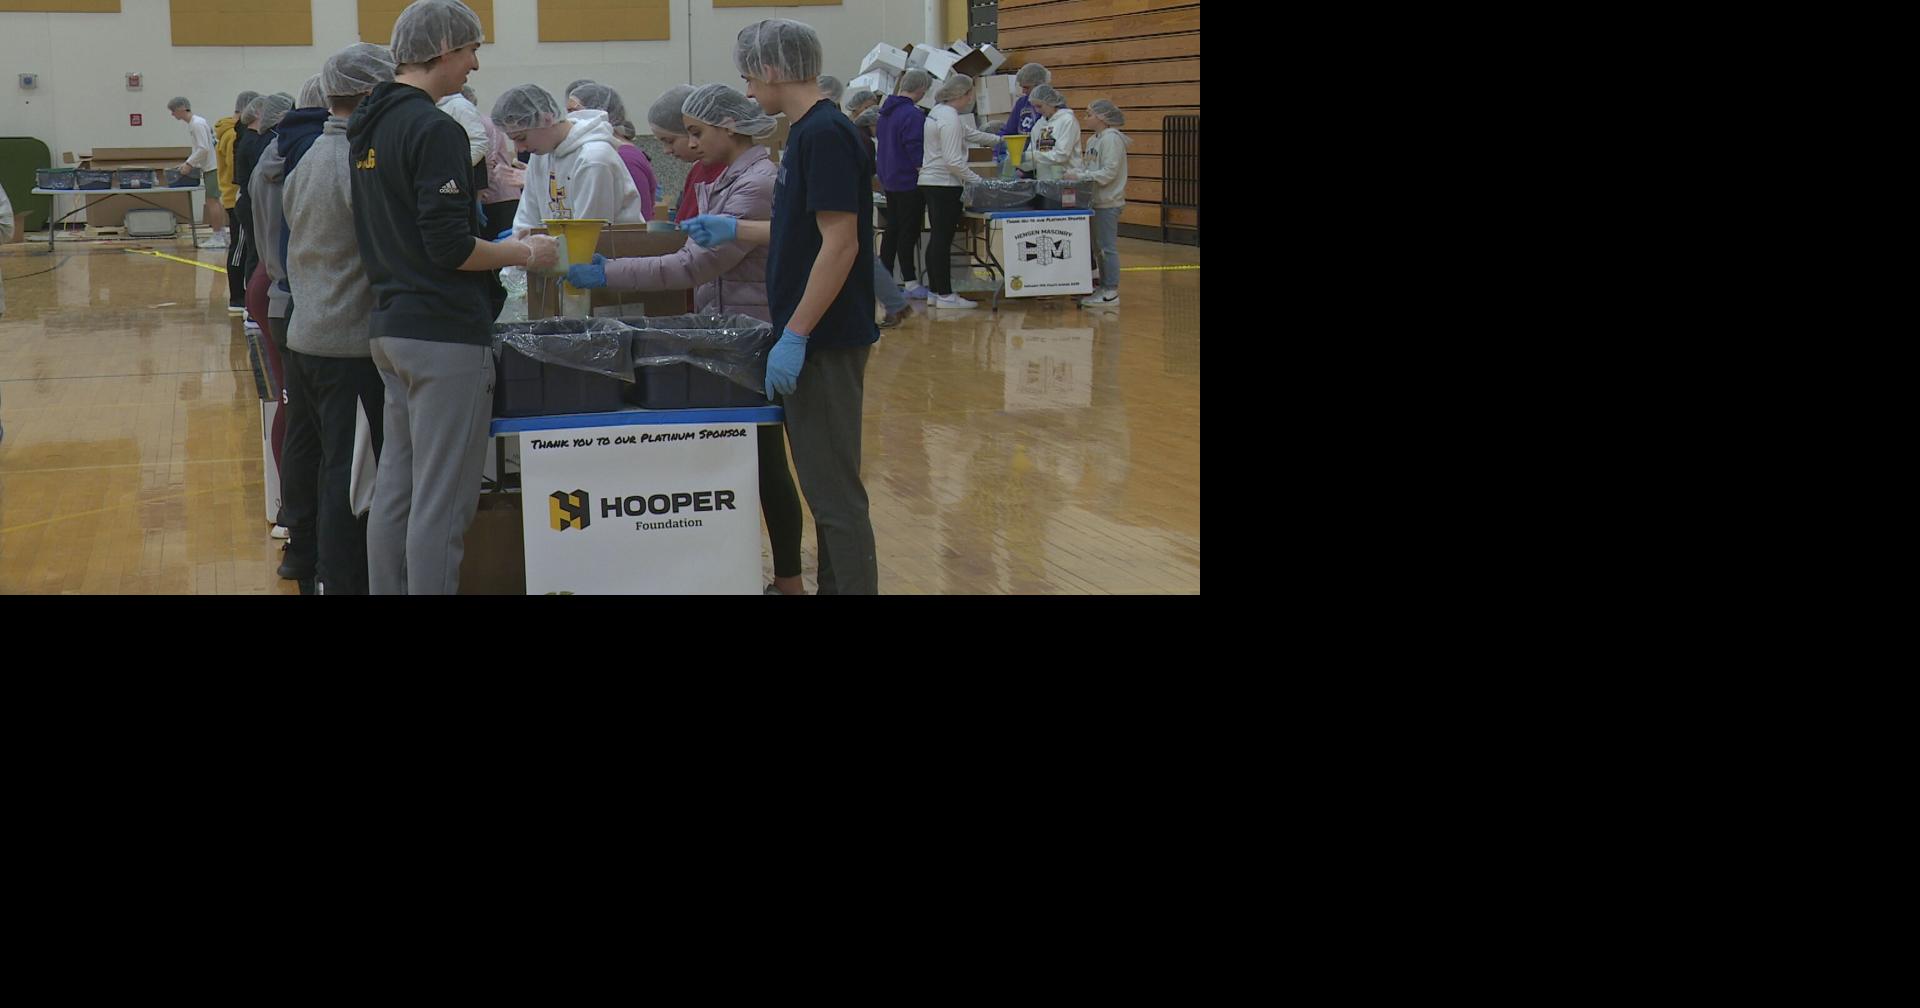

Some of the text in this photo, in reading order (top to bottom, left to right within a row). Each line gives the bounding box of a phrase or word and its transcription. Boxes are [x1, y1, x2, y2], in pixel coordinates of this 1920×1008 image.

[531, 428, 748, 450] THANK YOU TO OUR PLATINUM SPONSOR
[601, 490, 737, 518] HOOPER
[635, 518, 703, 531] Foundation
